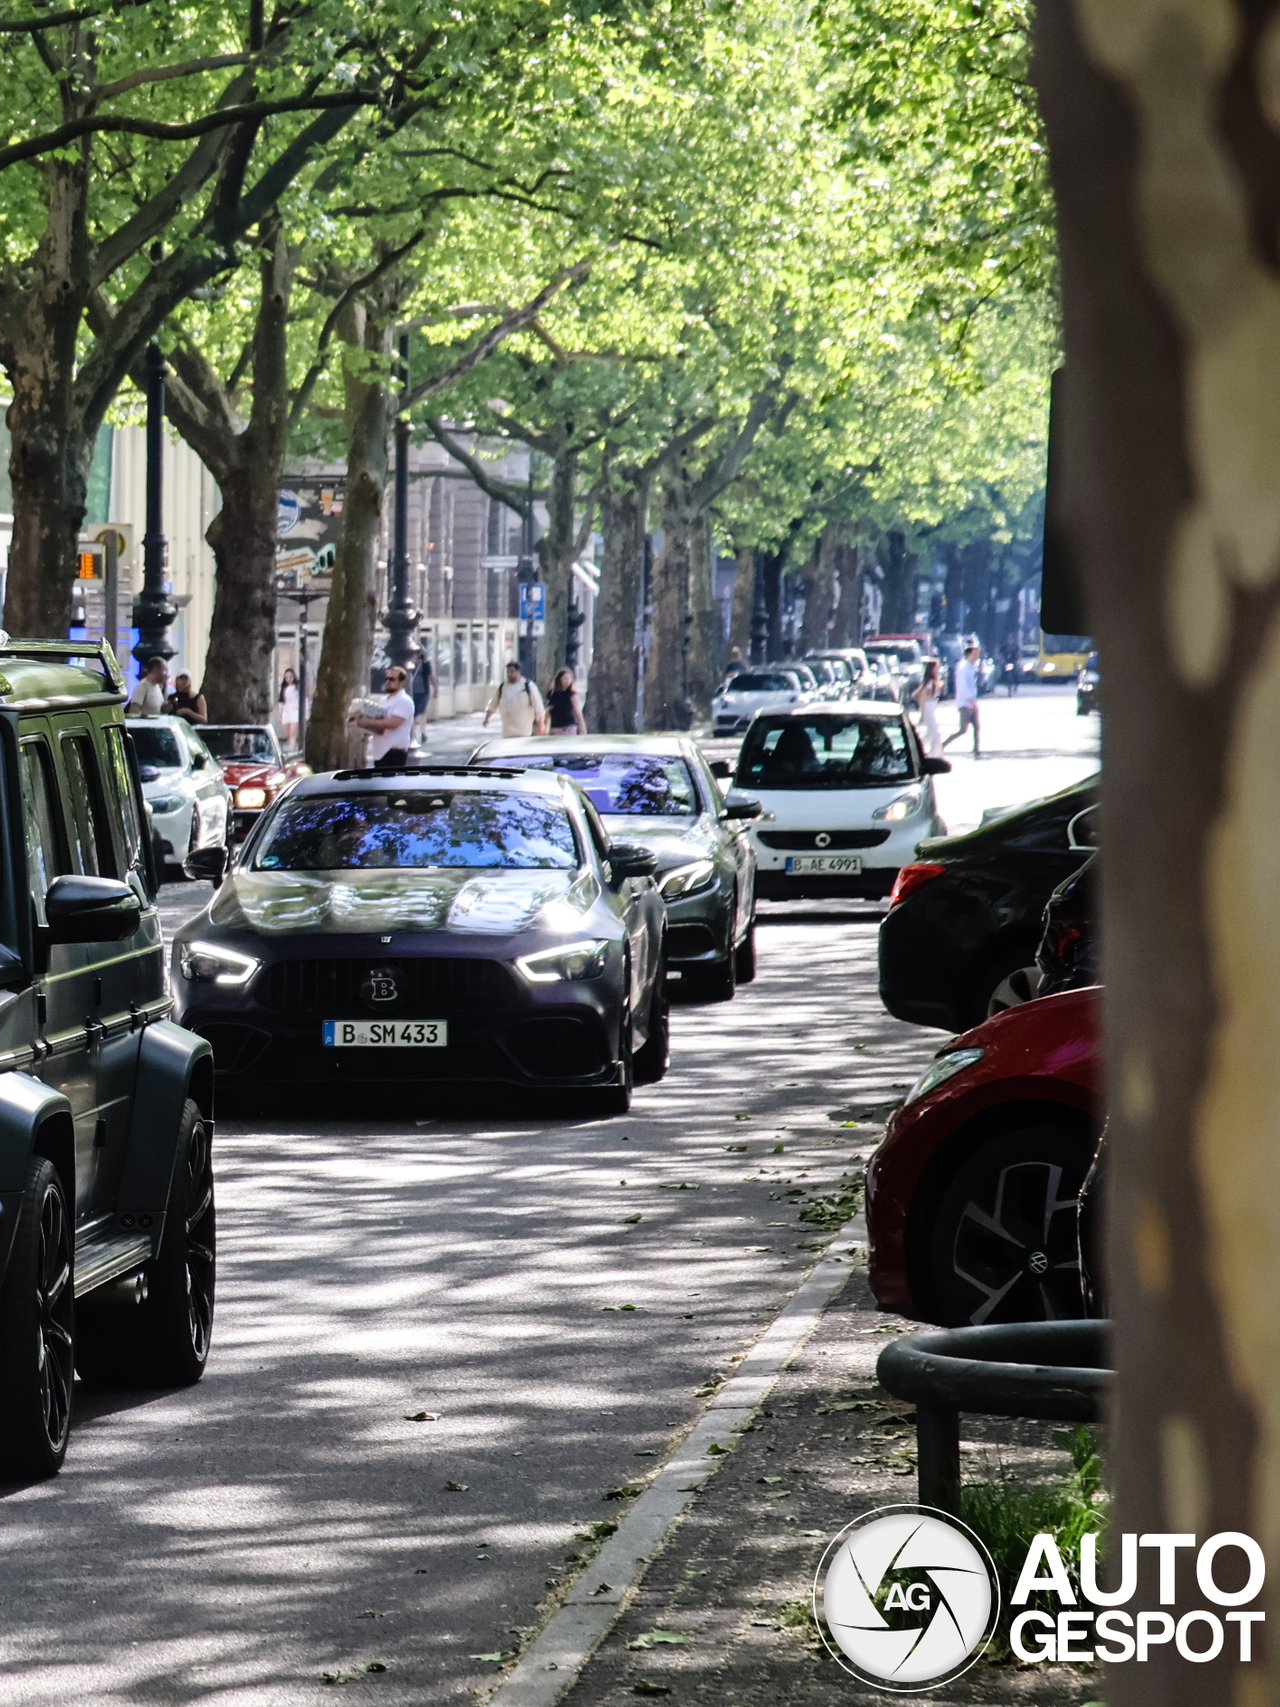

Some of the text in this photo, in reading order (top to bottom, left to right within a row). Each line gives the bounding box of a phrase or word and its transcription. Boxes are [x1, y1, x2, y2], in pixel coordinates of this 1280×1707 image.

[794, 859, 858, 871] B AE 4991
[343, 1024, 438, 1044] B SM 433
